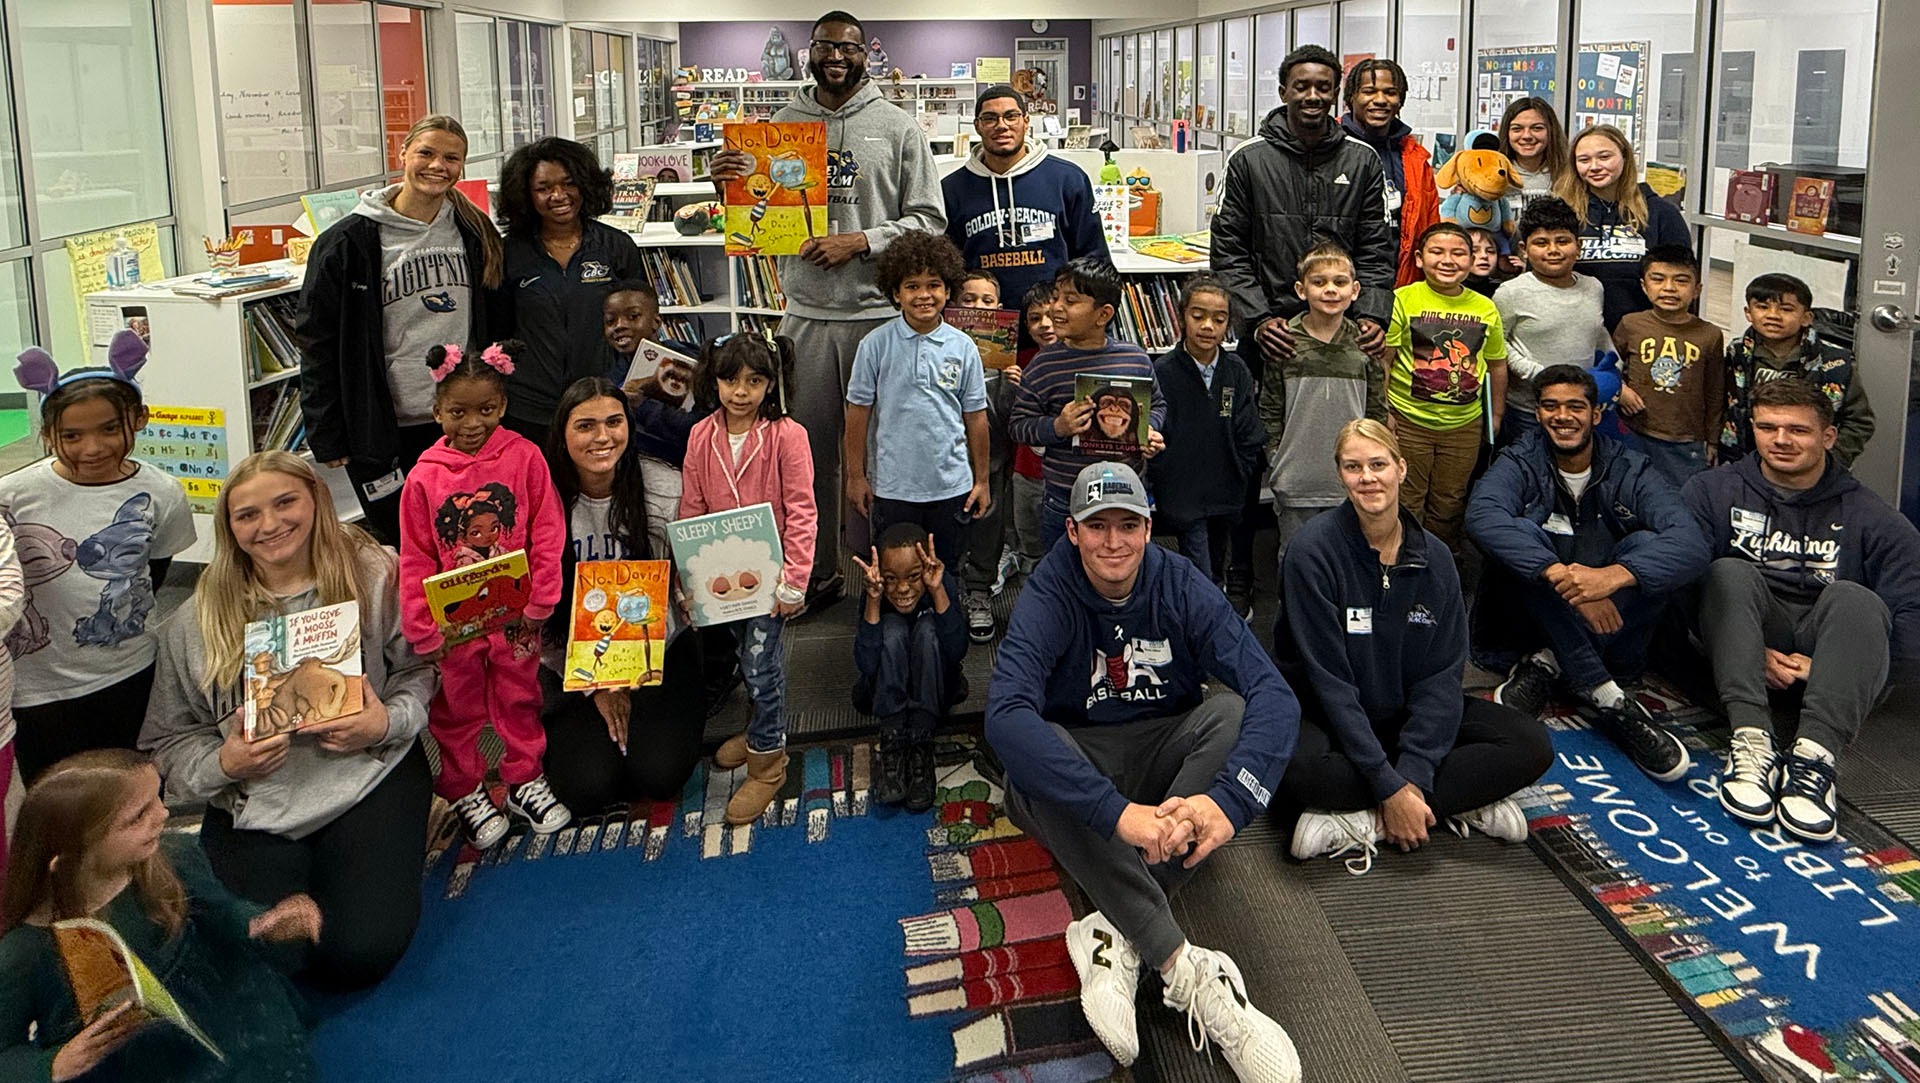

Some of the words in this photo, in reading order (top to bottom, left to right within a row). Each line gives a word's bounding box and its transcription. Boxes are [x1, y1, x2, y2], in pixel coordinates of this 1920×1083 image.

[702, 68, 748, 83] READ
[1512, 78, 1556, 92] PICTUR
[1578, 78, 1605, 92] OOK
[1028, 101, 1057, 114] READ
[1585, 96, 1632, 110] MONTH
[763, 123, 824, 149] David!
[980, 249, 1046, 269] BASEBALL
[1420, 310, 1442, 324] RIDE
[1445, 312, 1482, 327] BEYOND
[1640, 336, 1701, 365] GAP
[676, 520, 717, 542] SLEEPY
[721, 512, 763, 535] SHEEPY
[615, 563, 669, 586] David!
[289, 616, 299, 628] IF
[301, 611, 318, 624] YOU
[319, 607, 342, 620] GIVE
[294, 627, 301, 637] A
[304, 619, 336, 634] MOOSE
[293, 638, 300, 648] A
[303, 629, 338, 645] MUFFIN
[1085, 687, 1168, 710] BASEBALL
[1671, 804, 1729, 846] our
[1685, 761, 1900, 927] LIBRR
[1558, 751, 1821, 980] WELCOME
[1735, 855, 1771, 882] to
